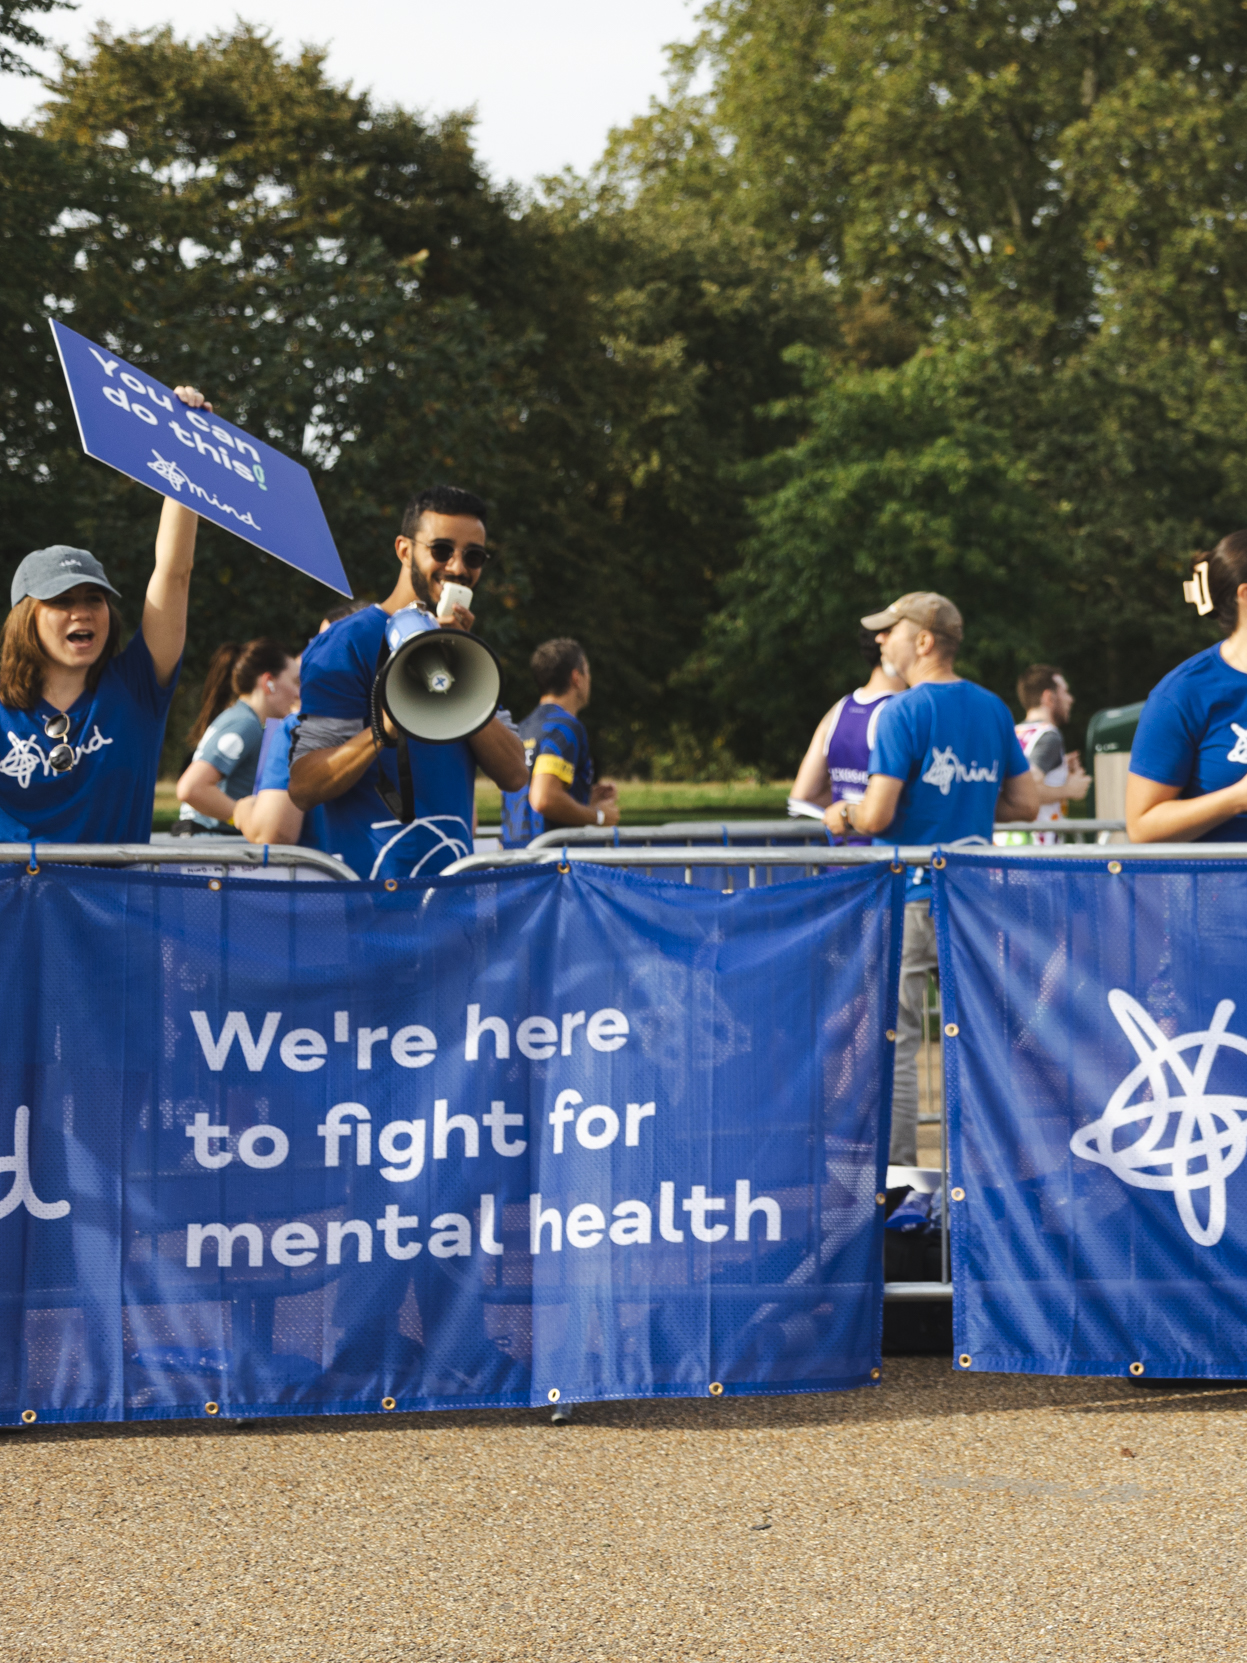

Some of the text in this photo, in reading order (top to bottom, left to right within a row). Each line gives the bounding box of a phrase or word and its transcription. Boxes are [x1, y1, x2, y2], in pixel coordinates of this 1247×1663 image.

[88, 346, 261, 463] You can
[102, 386, 268, 492] do this!
[191, 1003, 630, 1072] We're here
[186, 1088, 656, 1182] to fight for
[186, 1178, 782, 1268] mental health
